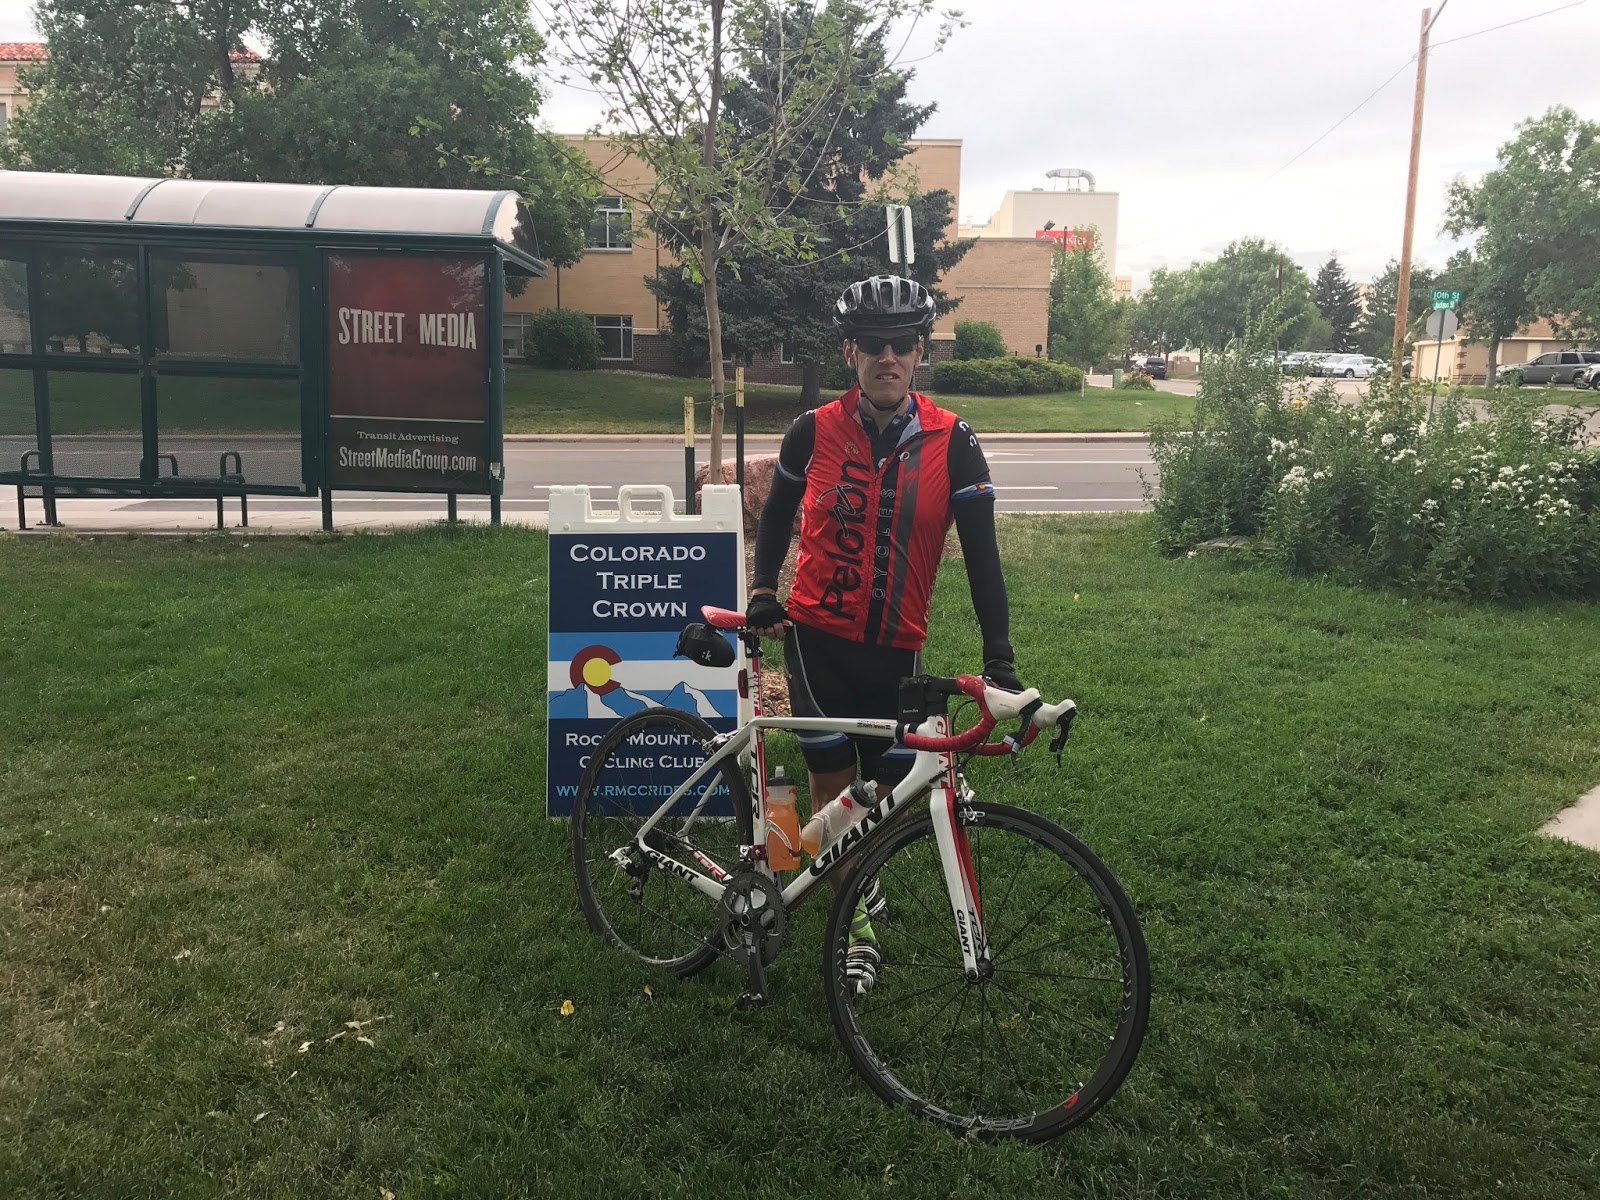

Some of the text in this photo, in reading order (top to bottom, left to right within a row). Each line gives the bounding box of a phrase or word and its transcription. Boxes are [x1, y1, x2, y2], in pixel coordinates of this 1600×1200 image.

[1433, 291, 1460, 300] 10th St
[338, 306, 477, 350] STREET MEDIA
[357, 431, 459, 445] Transit Advertising
[339, 446, 477, 474] StreetMediaGroup.com
[569, 543, 707, 562] COLORADO
[819, 460, 871, 622] Peloton
[872, 488, 896, 600] CYCLES
[596, 571, 682, 590] TRIPLE
[592, 599, 687, 618] CROWN
[565, 732, 702, 746] ROC MOUNTA
[579, 755, 654, 769] CCLING
[809, 793, 896, 878] GIANT
[648, 850, 699, 882] GIANT
[956, 908, 972, 957] GIANT
